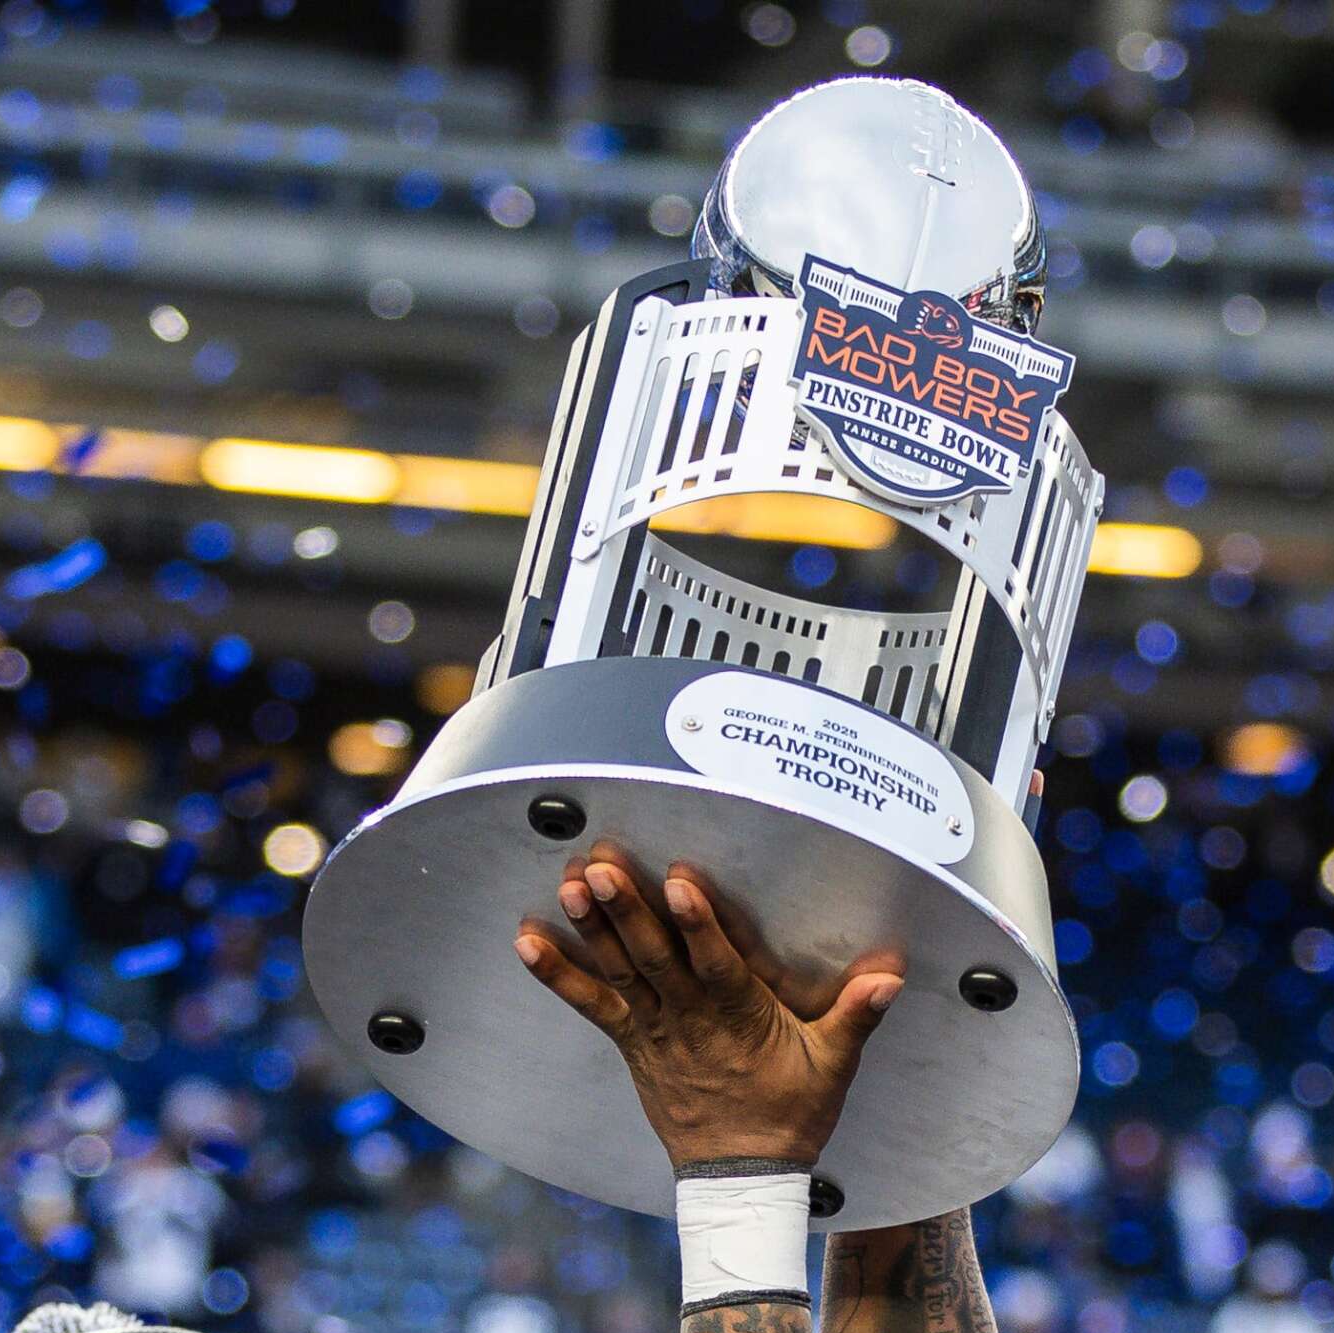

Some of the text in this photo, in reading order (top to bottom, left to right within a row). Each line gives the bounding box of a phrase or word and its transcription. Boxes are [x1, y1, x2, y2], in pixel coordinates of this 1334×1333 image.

[806, 334, 1031, 442] MOWERS
[814, 306, 1038, 409] BAD BOY
[805, 378, 1012, 478] PINSTRIPE BOWL
[842, 420, 967, 477] YANKEE STADIUM
[720, 723, 936, 816] CHAMPIONSHIP
[723, 706, 939, 798] GEORGE M. STEINBRENNER III
[822, 718, 858, 739] 2025
[775, 757, 887, 813] TROPHY
